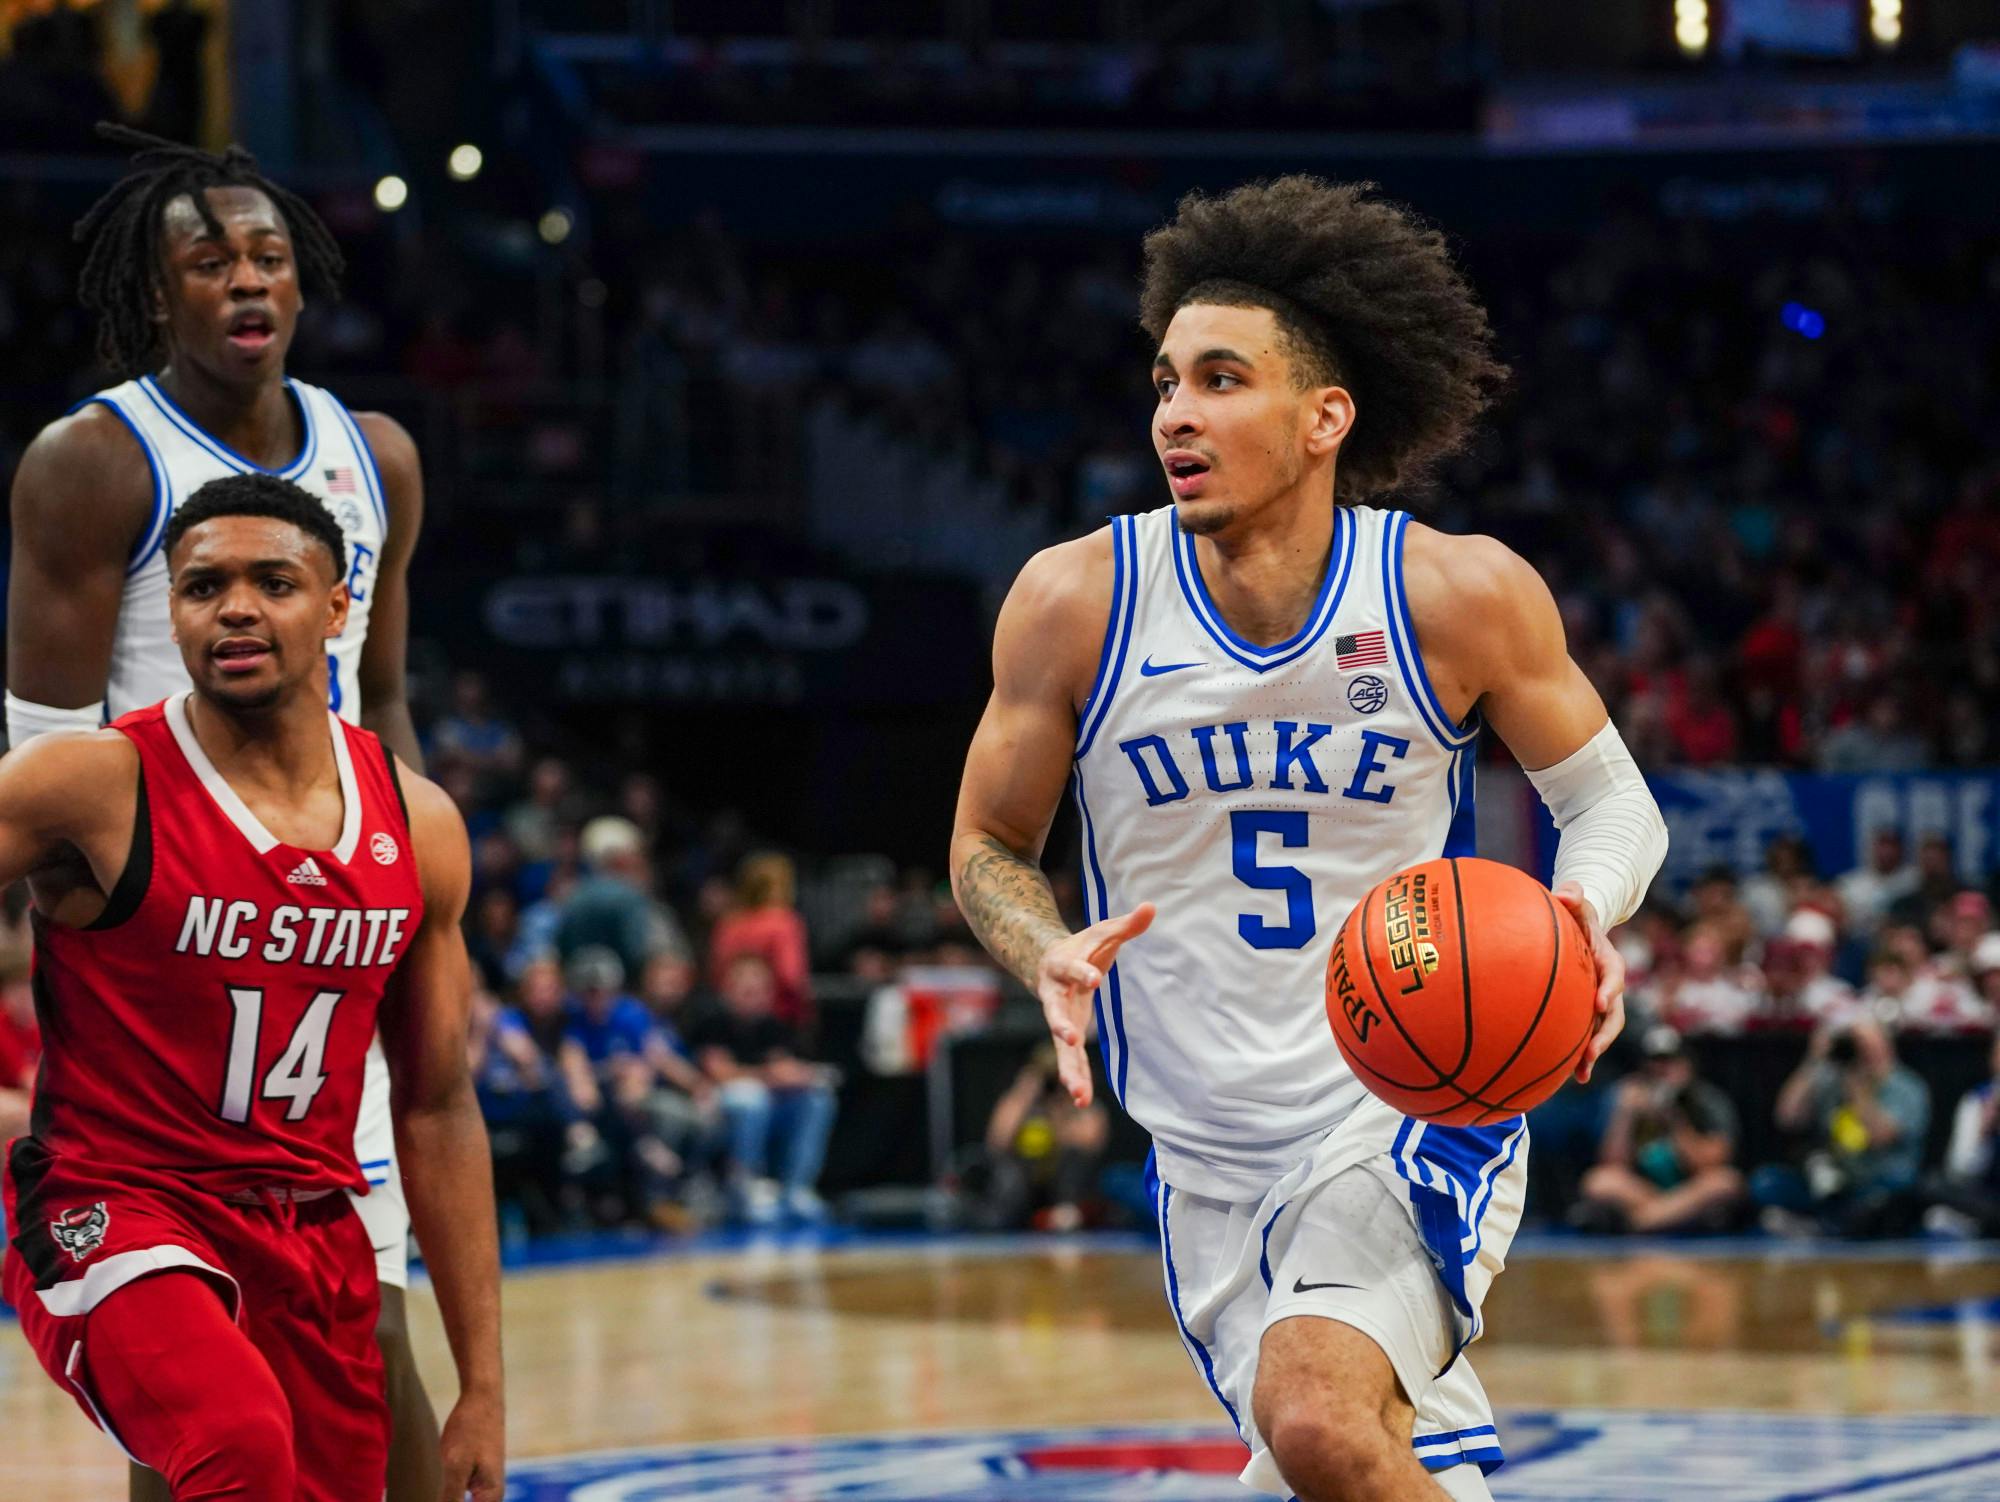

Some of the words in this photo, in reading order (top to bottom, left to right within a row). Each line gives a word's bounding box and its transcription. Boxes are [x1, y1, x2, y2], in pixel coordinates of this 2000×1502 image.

[485, 577, 868, 650] ETIHAD
[1119, 721, 1410, 807] DUKE
[287, 874, 328, 886] adidas
[1230, 811, 1316, 949] 5
[1413, 874, 1430, 939] 1000
[176, 896, 258, 959] NC
[263, 905, 410, 967] STATE
[1385, 874, 1424, 996] LEGACY
[1333, 926, 1381, 1044] SPALD
[218, 985, 346, 1125] 14
